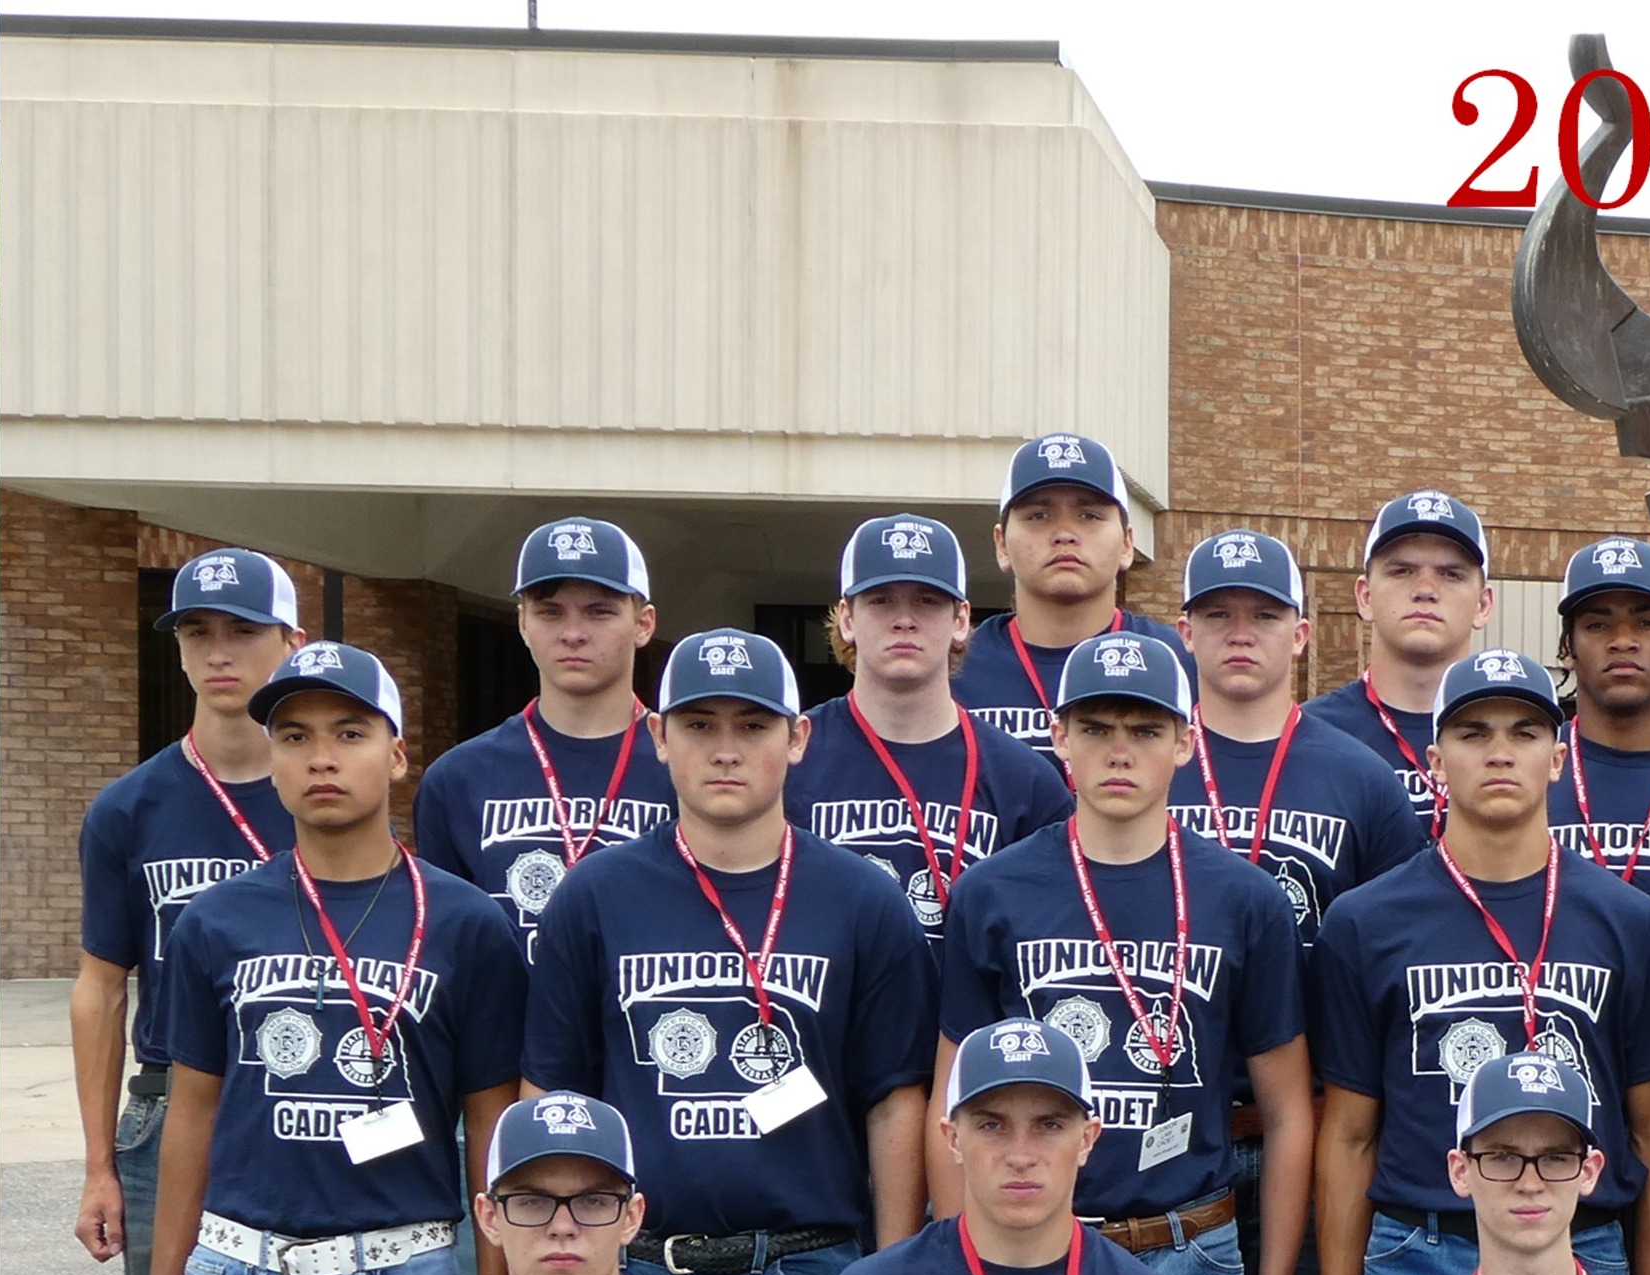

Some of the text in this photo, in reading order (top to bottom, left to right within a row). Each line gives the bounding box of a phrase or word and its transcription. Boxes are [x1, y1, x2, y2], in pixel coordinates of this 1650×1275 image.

[481, 797, 671, 849] JUNIOR LAW
[925, 801, 999, 856] LAW
[1270, 806, 1347, 870] LAW
[619, 952, 744, 1005] JUNIOR
[1016, 940, 1223, 1001] JUNIOR LAW
[1406, 961, 1611, 1023] JUNIOR LAW
[664, 1057, 703, 1071] LEGION
[1087, 1090, 1158, 1129] ADET
